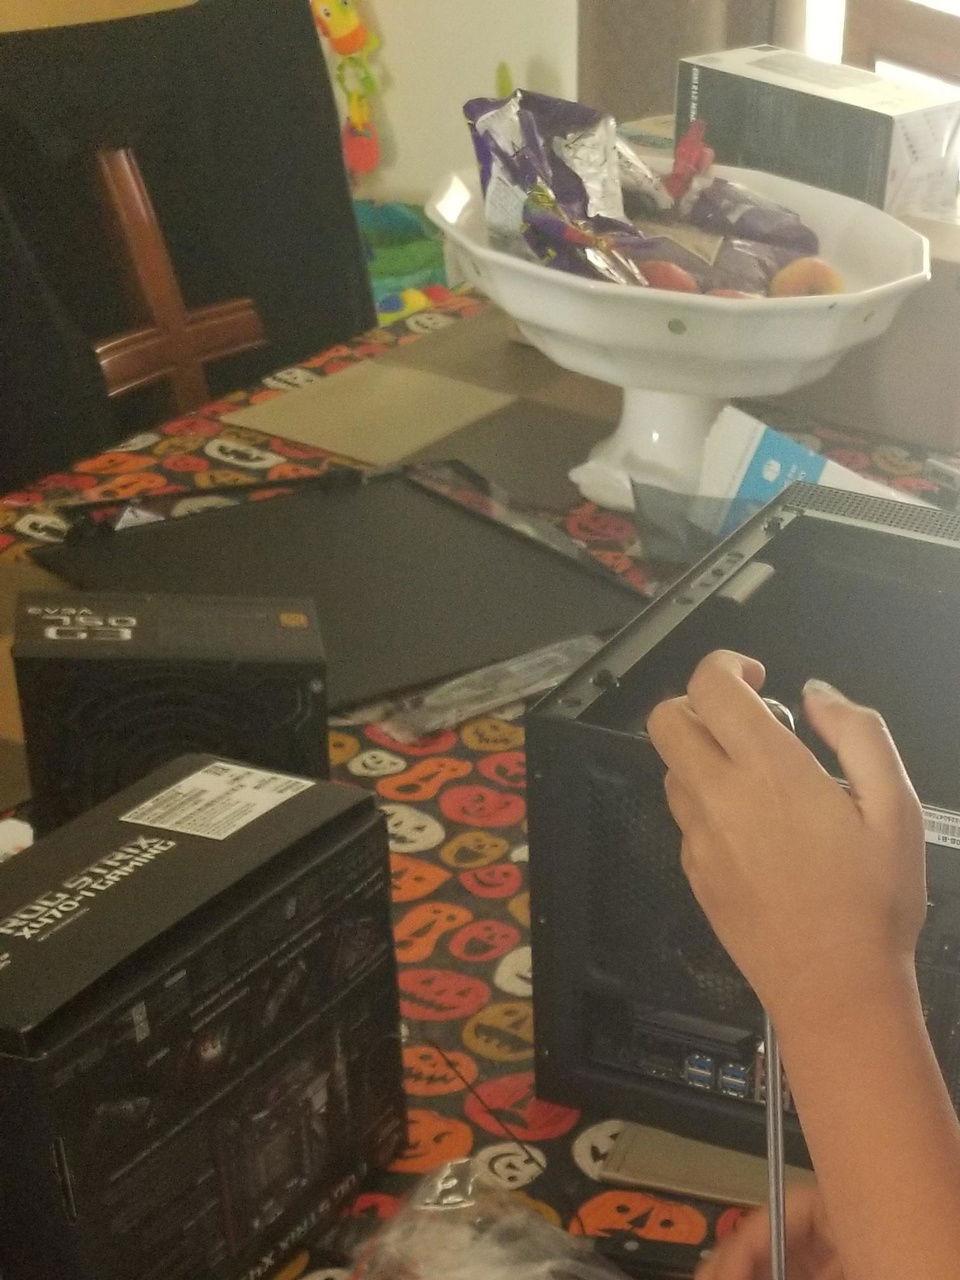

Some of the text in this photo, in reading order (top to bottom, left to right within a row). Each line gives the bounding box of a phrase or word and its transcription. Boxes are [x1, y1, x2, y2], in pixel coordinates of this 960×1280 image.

[41, 615, 138, 627] 750
[44, 626, 133, 641] G3
[62, 834, 161, 891] STRIX
[14, 890, 96, 940] X470-I
[92, 839, 177, 891] GAMING
